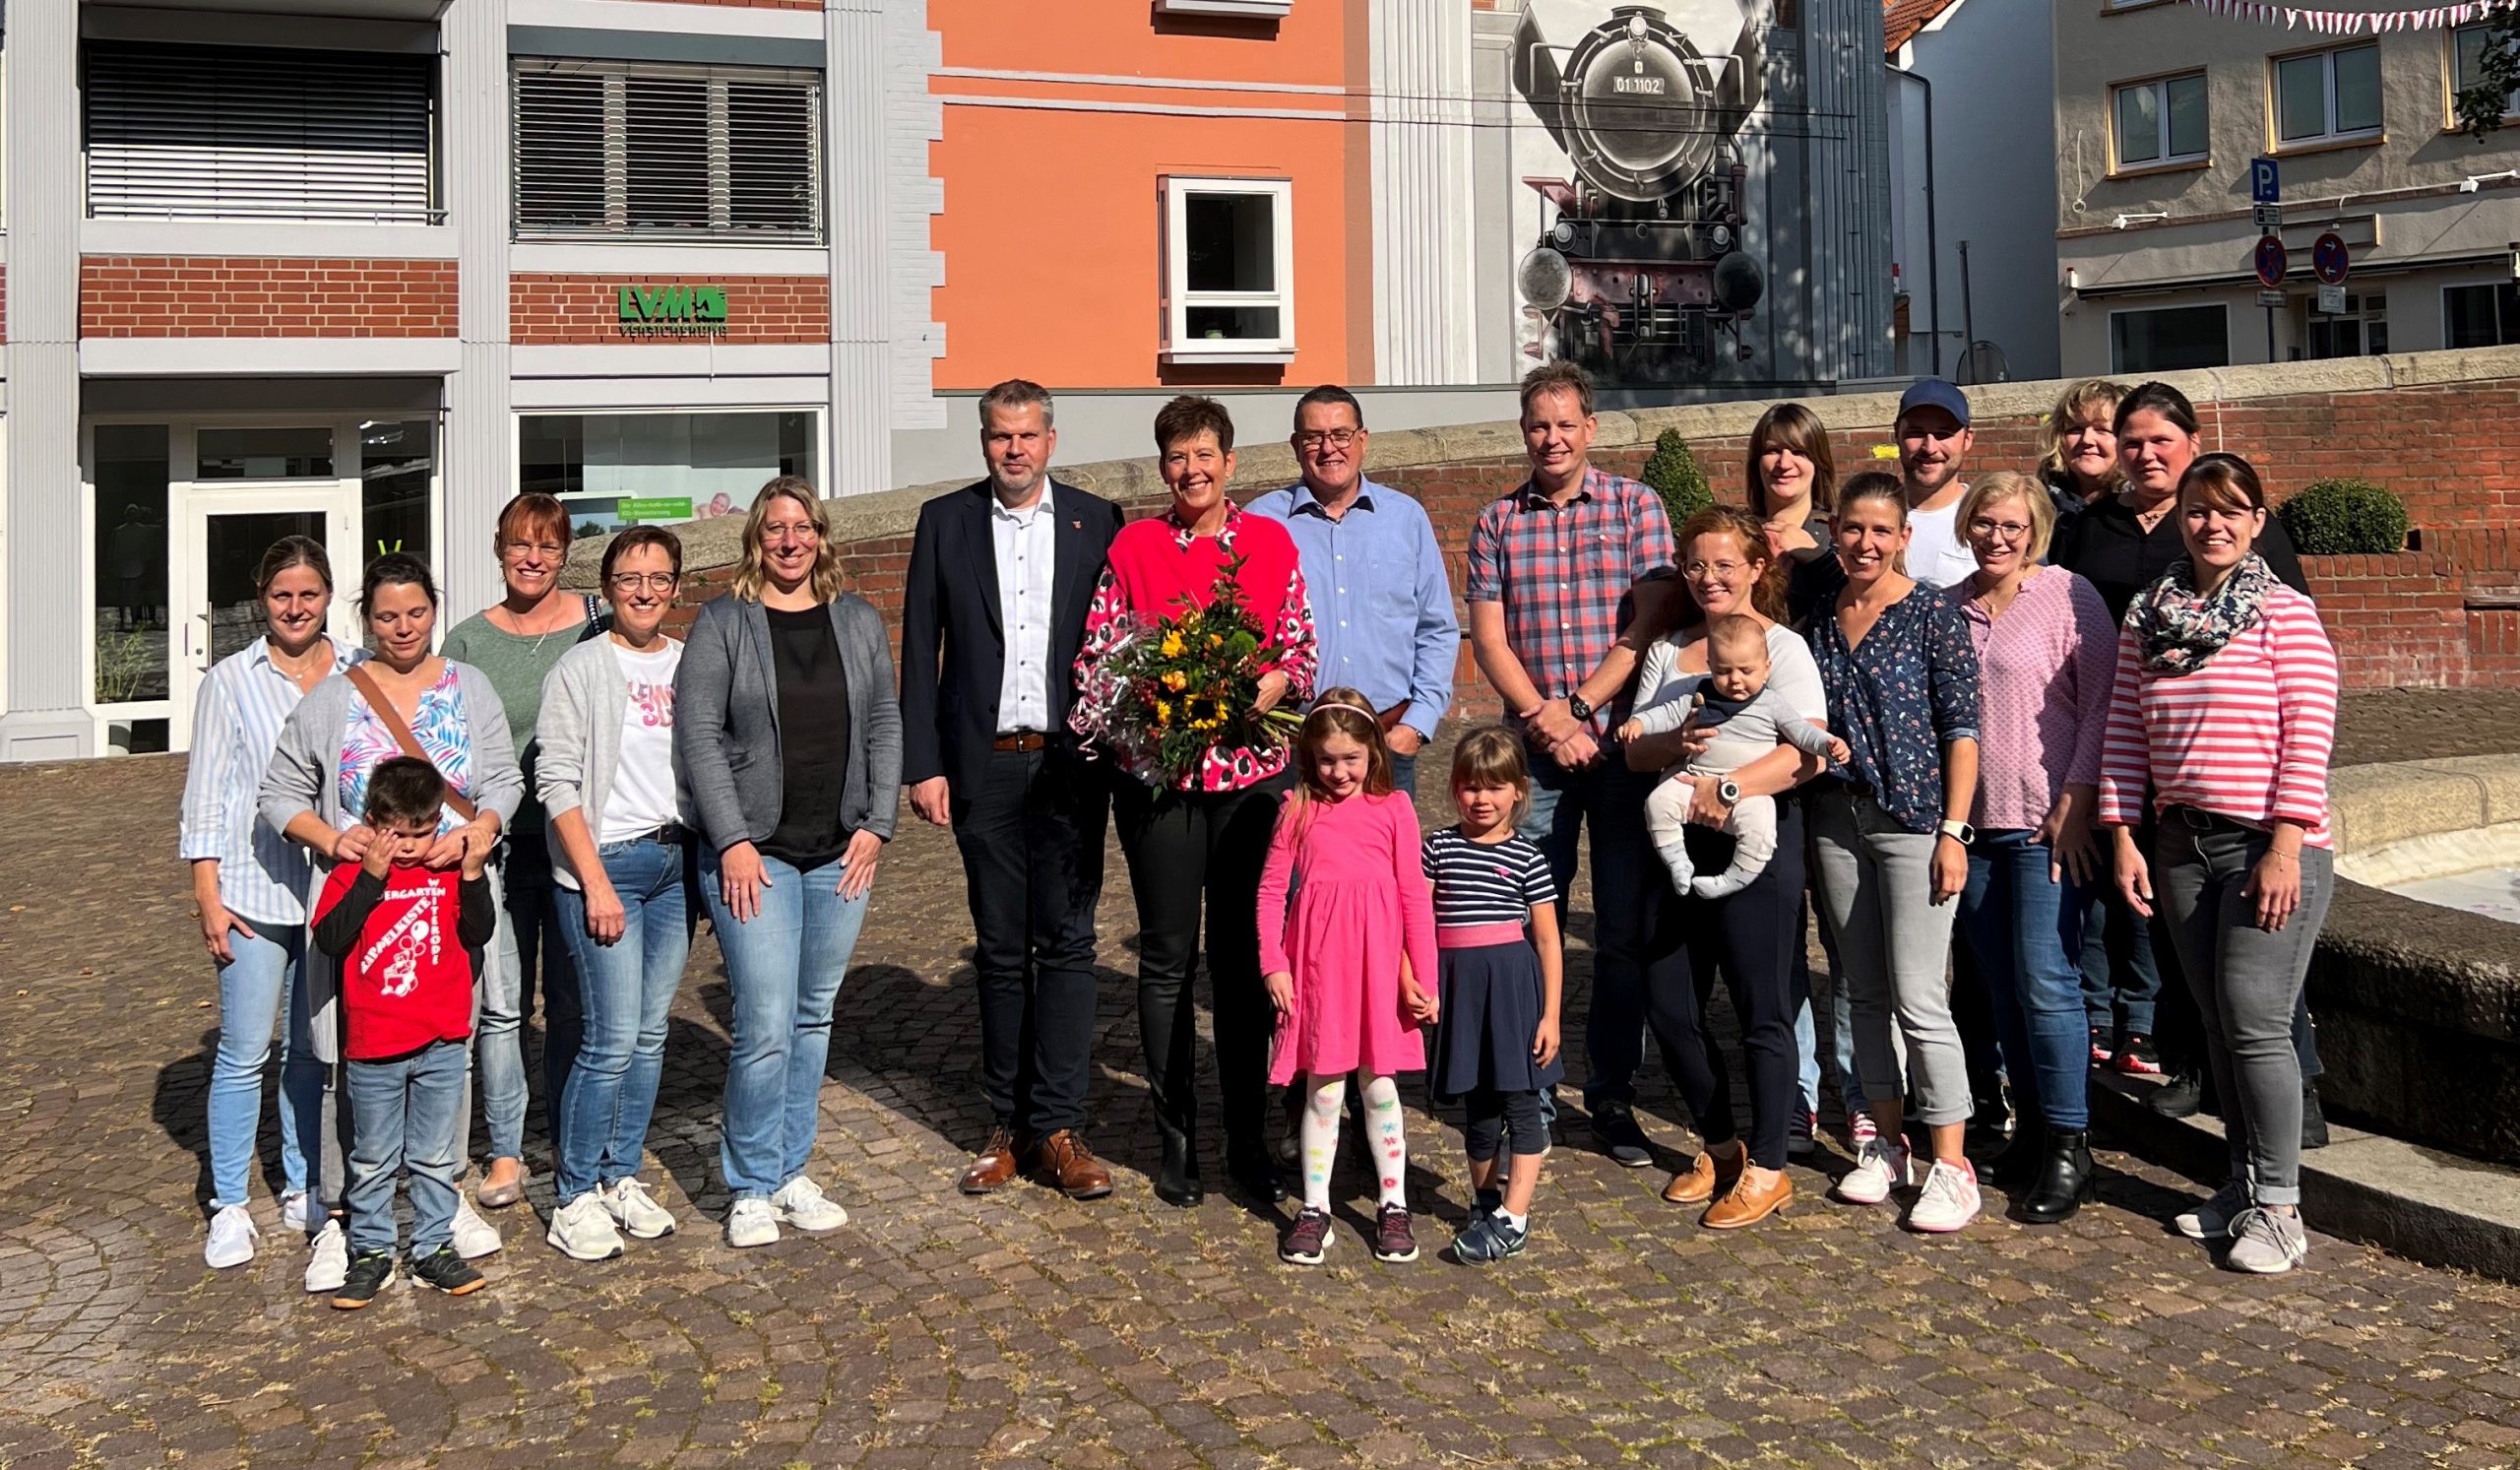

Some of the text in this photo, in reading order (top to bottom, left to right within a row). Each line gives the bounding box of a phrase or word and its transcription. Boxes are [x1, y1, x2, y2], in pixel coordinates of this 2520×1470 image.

[1616, 78, 1660, 93] 01 1102
[2257, 164, 2273, 197] P
[619, 286, 692, 319] LVM
[619, 322, 727, 338] VERSICHERUNG
[379, 887, 446, 901] ERGARTEN
[360, 896, 431, 975] RAPPELKISTE
